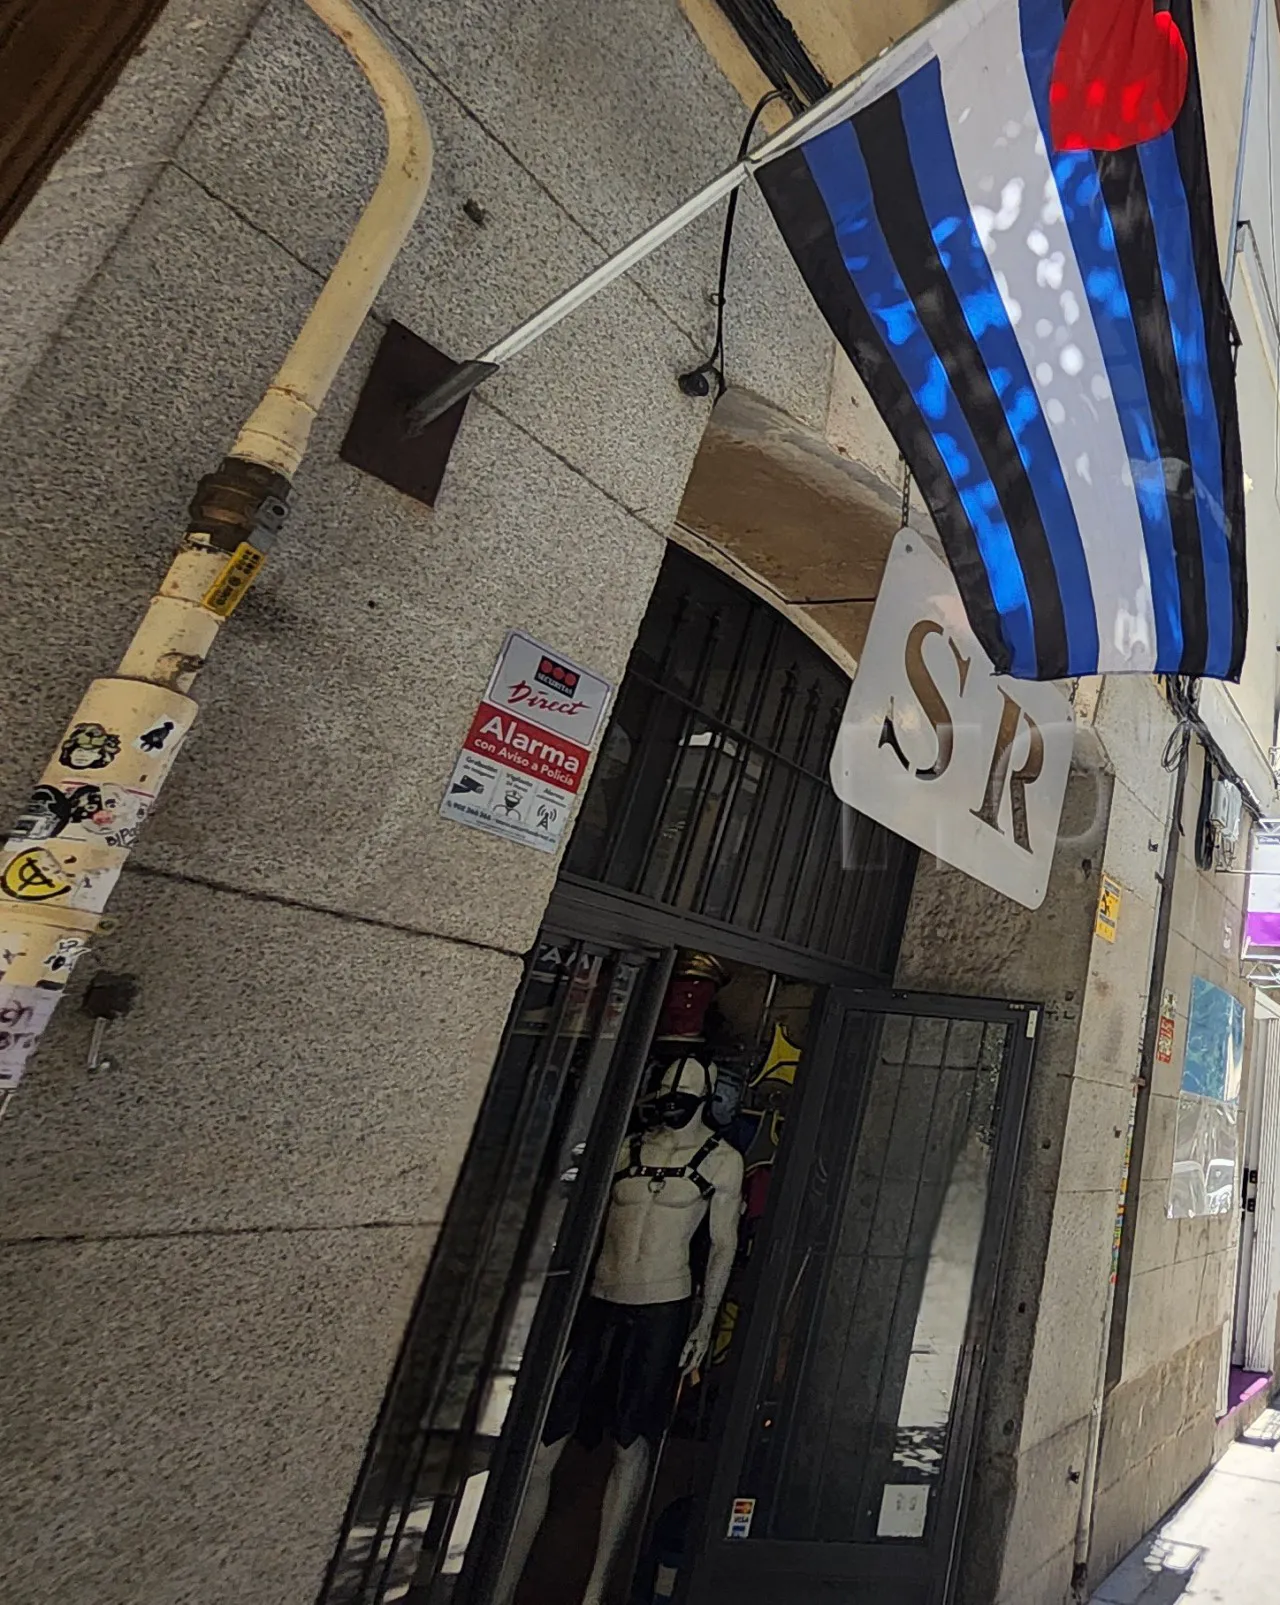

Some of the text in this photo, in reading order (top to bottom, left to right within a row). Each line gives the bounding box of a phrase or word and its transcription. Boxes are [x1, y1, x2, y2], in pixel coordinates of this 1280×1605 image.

[506, 679, 592, 716] Direct
[474, 738, 496, 753] con
[498, 745, 529, 768] Aviso
[530, 763, 539, 772] a
[541, 764, 575, 786] Policía
[479, 715, 580, 774] Alarma
